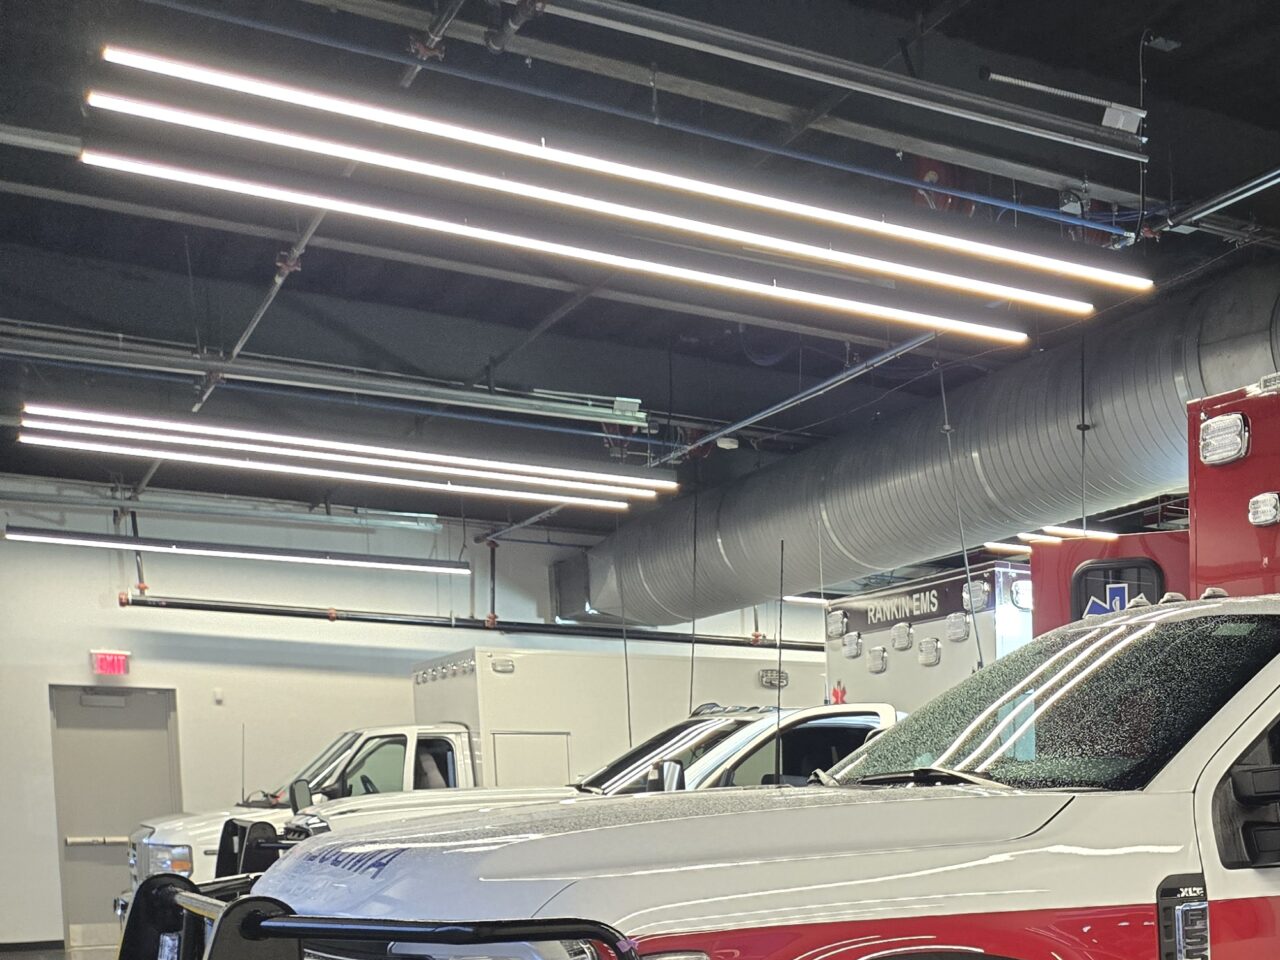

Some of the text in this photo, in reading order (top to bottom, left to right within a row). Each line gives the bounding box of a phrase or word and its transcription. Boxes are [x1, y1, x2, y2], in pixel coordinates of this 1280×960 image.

[867, 589, 938, 625] RANKIN EMS
[96, 654, 126, 674] EXIT
